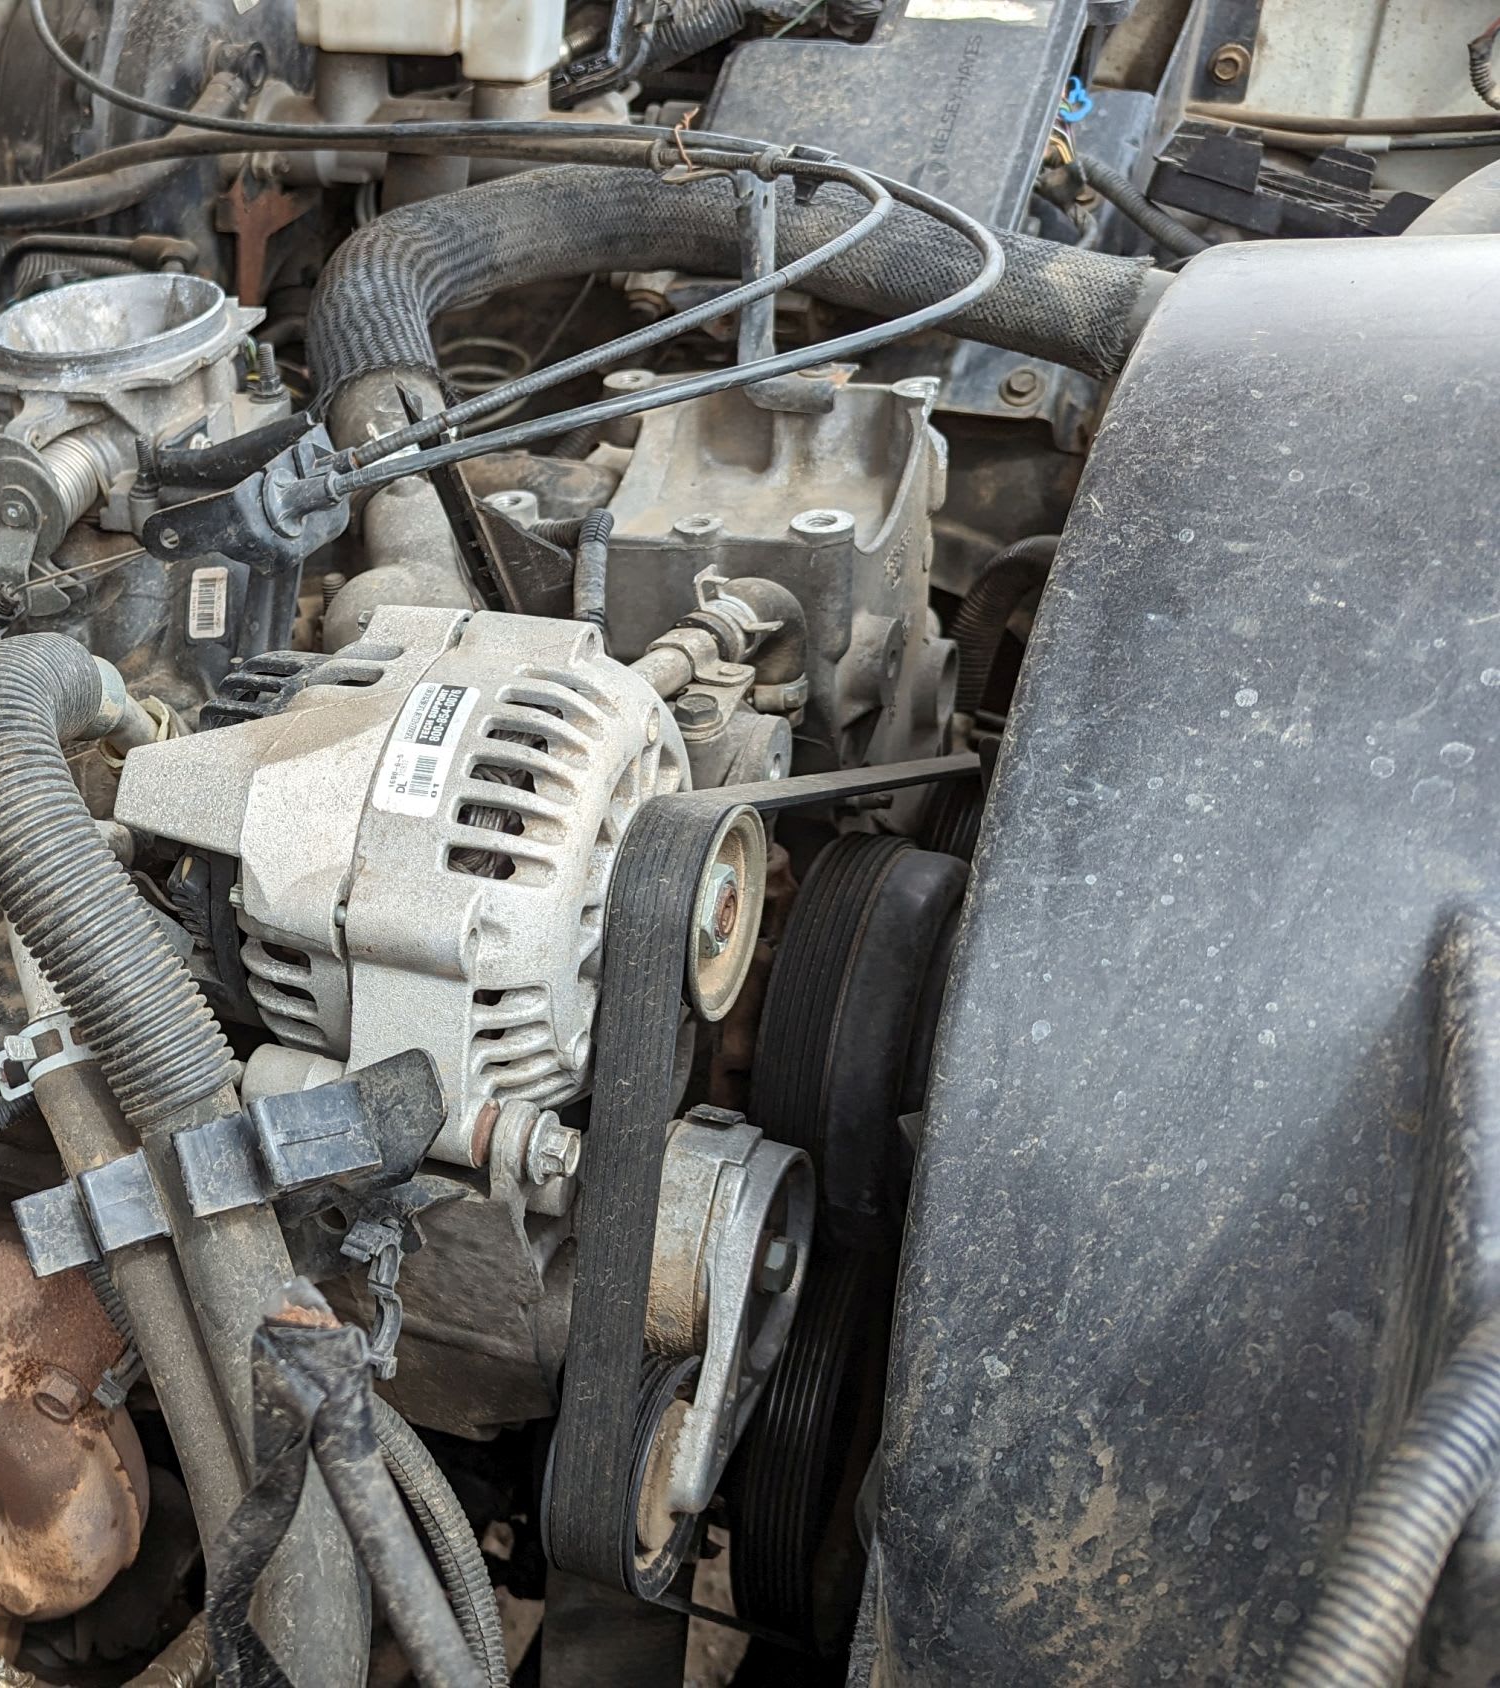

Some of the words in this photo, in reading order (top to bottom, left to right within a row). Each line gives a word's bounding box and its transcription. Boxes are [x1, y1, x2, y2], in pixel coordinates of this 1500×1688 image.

[419, 719, 435, 740] TECH
[428, 688, 450, 719] SUPPORT
[428, 688, 463, 742] 800-854-0076
[395, 781, 408, 794] DL
